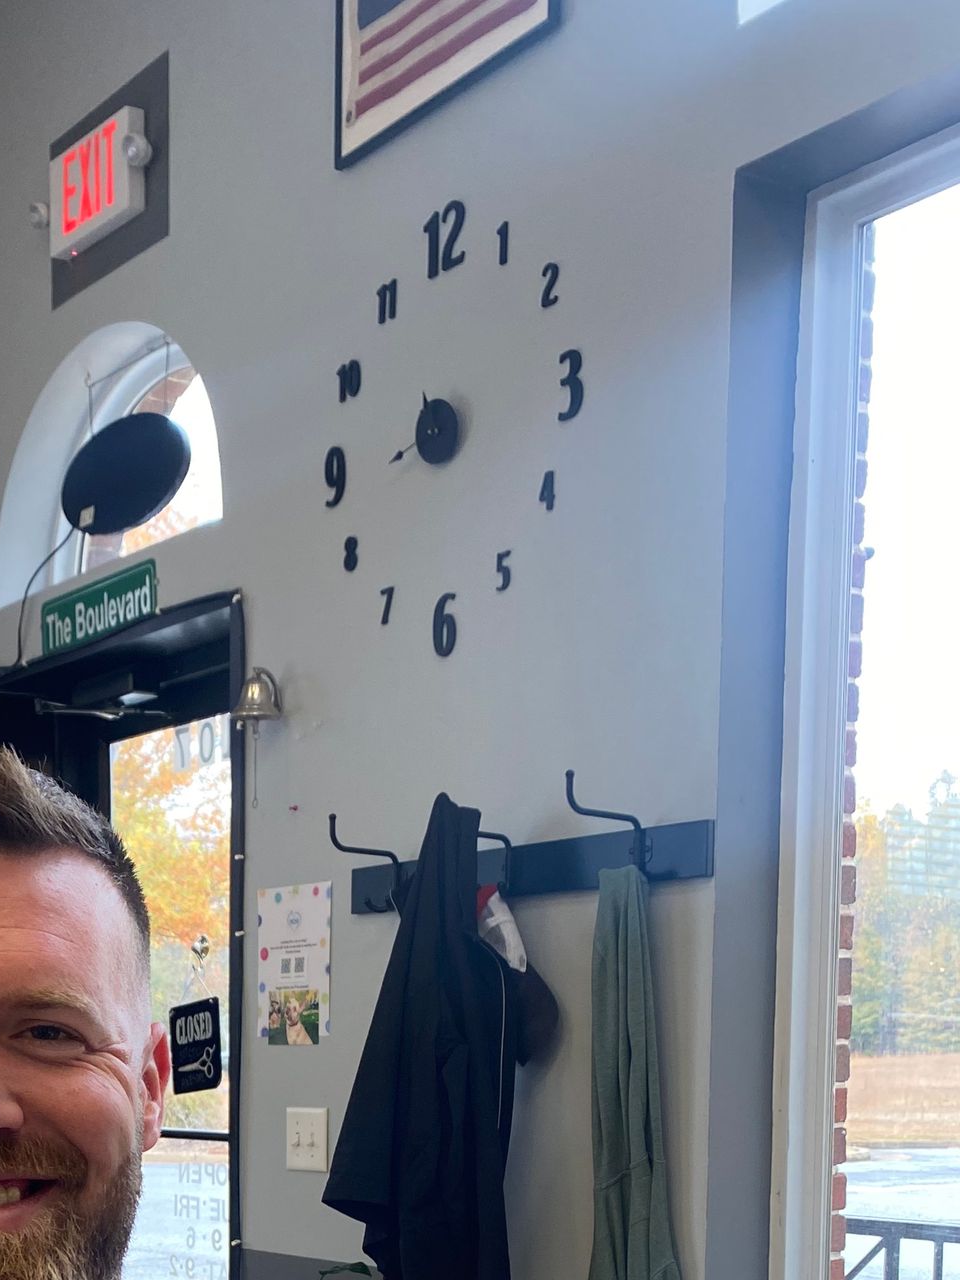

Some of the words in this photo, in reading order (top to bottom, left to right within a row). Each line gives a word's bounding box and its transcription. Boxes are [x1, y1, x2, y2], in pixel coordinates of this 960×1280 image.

[60, 119, 118, 237] EXIT
[423, 200, 466, 279] 12
[496, 220, 509, 266] 1
[376, 278, 398, 325] 11
[541, 262, 560, 308] 2
[336, 359, 362, 403] 10
[558, 349, 584, 421] 3
[325, 446, 346, 508] 9
[539, 470, 556, 511] 4
[344, 536, 358, 572] 8
[496, 550, 511, 592] 5
[46, 612, 72, 649] The
[74, 574, 151, 640] Boulevard
[380, 586, 395, 625] 7
[432, 592, 457, 657] 6
[176, 1011, 213, 1045] CLOSED
